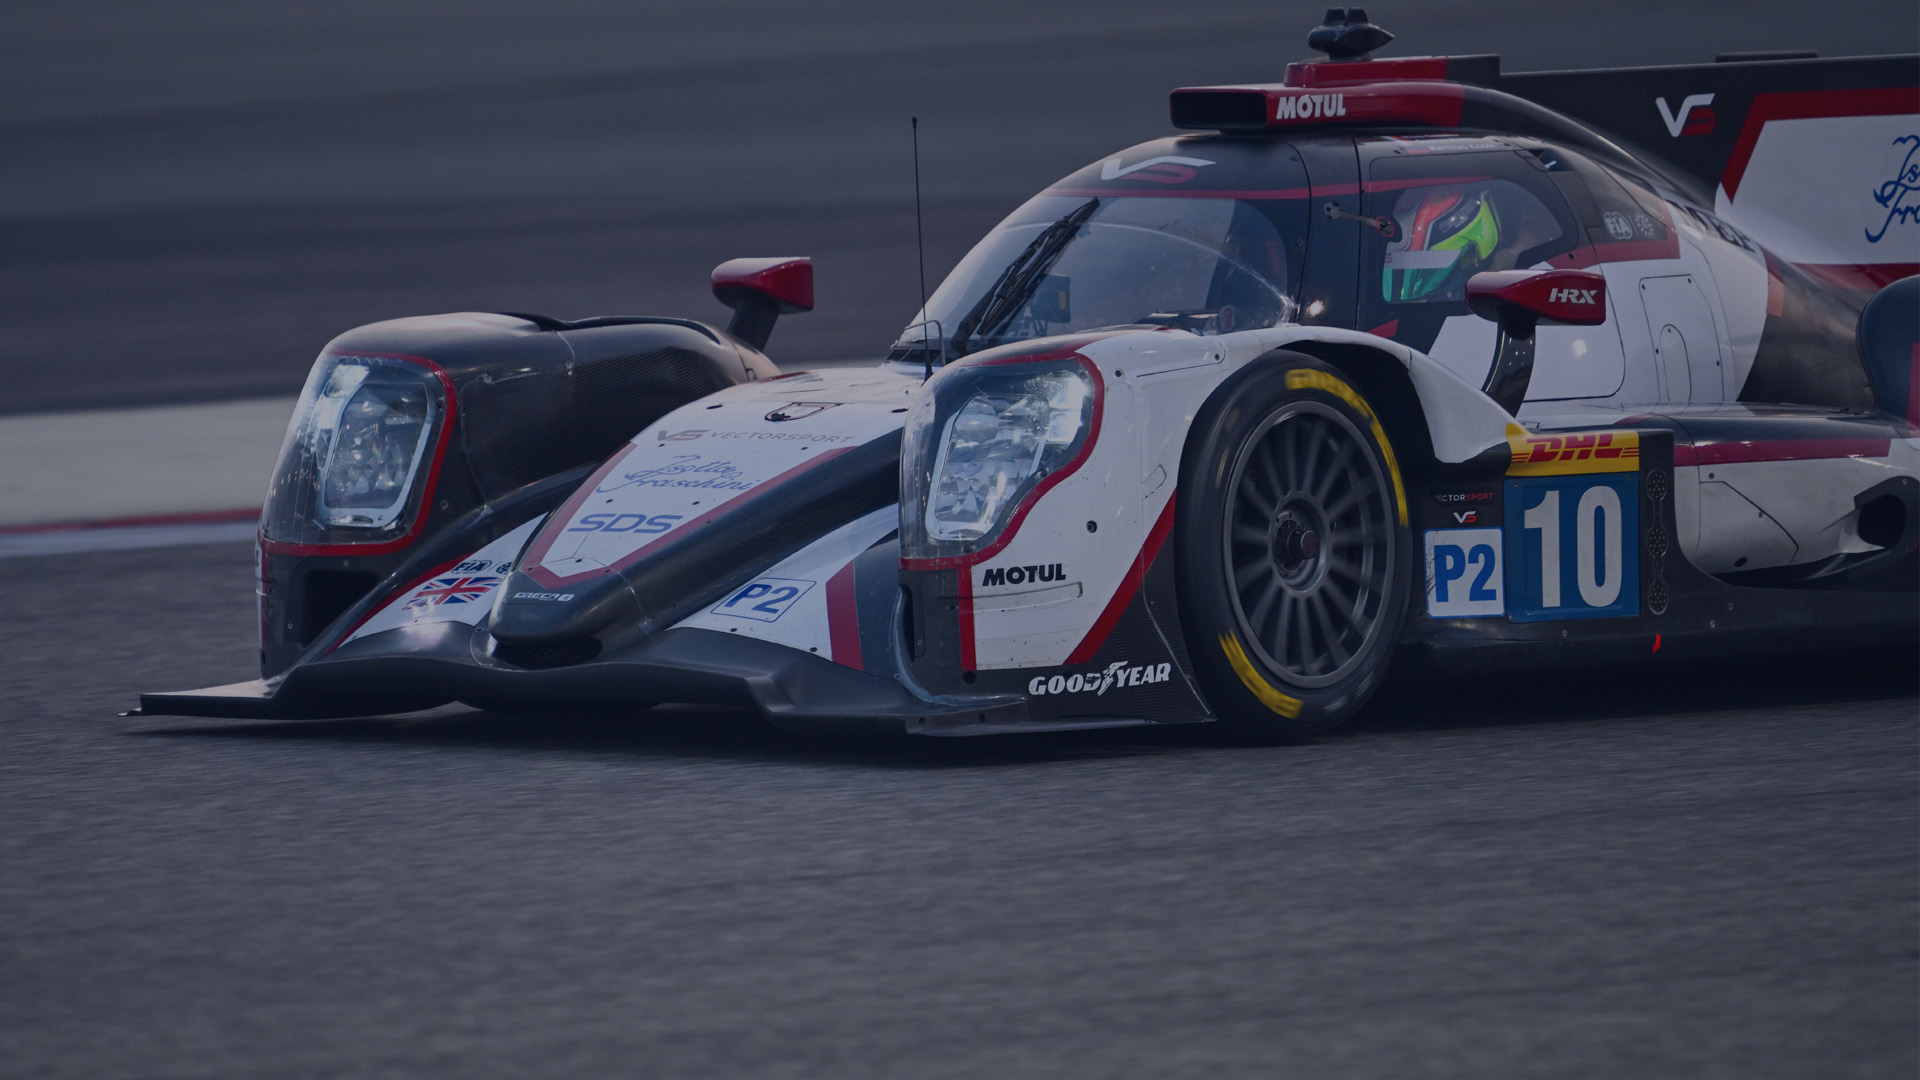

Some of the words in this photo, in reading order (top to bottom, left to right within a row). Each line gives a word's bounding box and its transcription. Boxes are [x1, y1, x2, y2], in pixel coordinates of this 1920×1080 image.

[1276, 93, 1347, 120] MOTUL
[1607, 214, 1630, 238] FIA
[1549, 287, 1598, 305] HRX
[710, 431, 856, 444] VECTORSPORT
[1526, 433, 1622, 463] DHL
[567, 513, 684, 534] SDS
[1523, 485, 1623, 608] 10
[452, 561, 489, 573] FIA
[982, 563, 1067, 587] MOTUL
[1434, 544, 1497, 603] P2
[725, 583, 800, 614] P2
[1028, 661, 1172, 696] GOODYEAR
